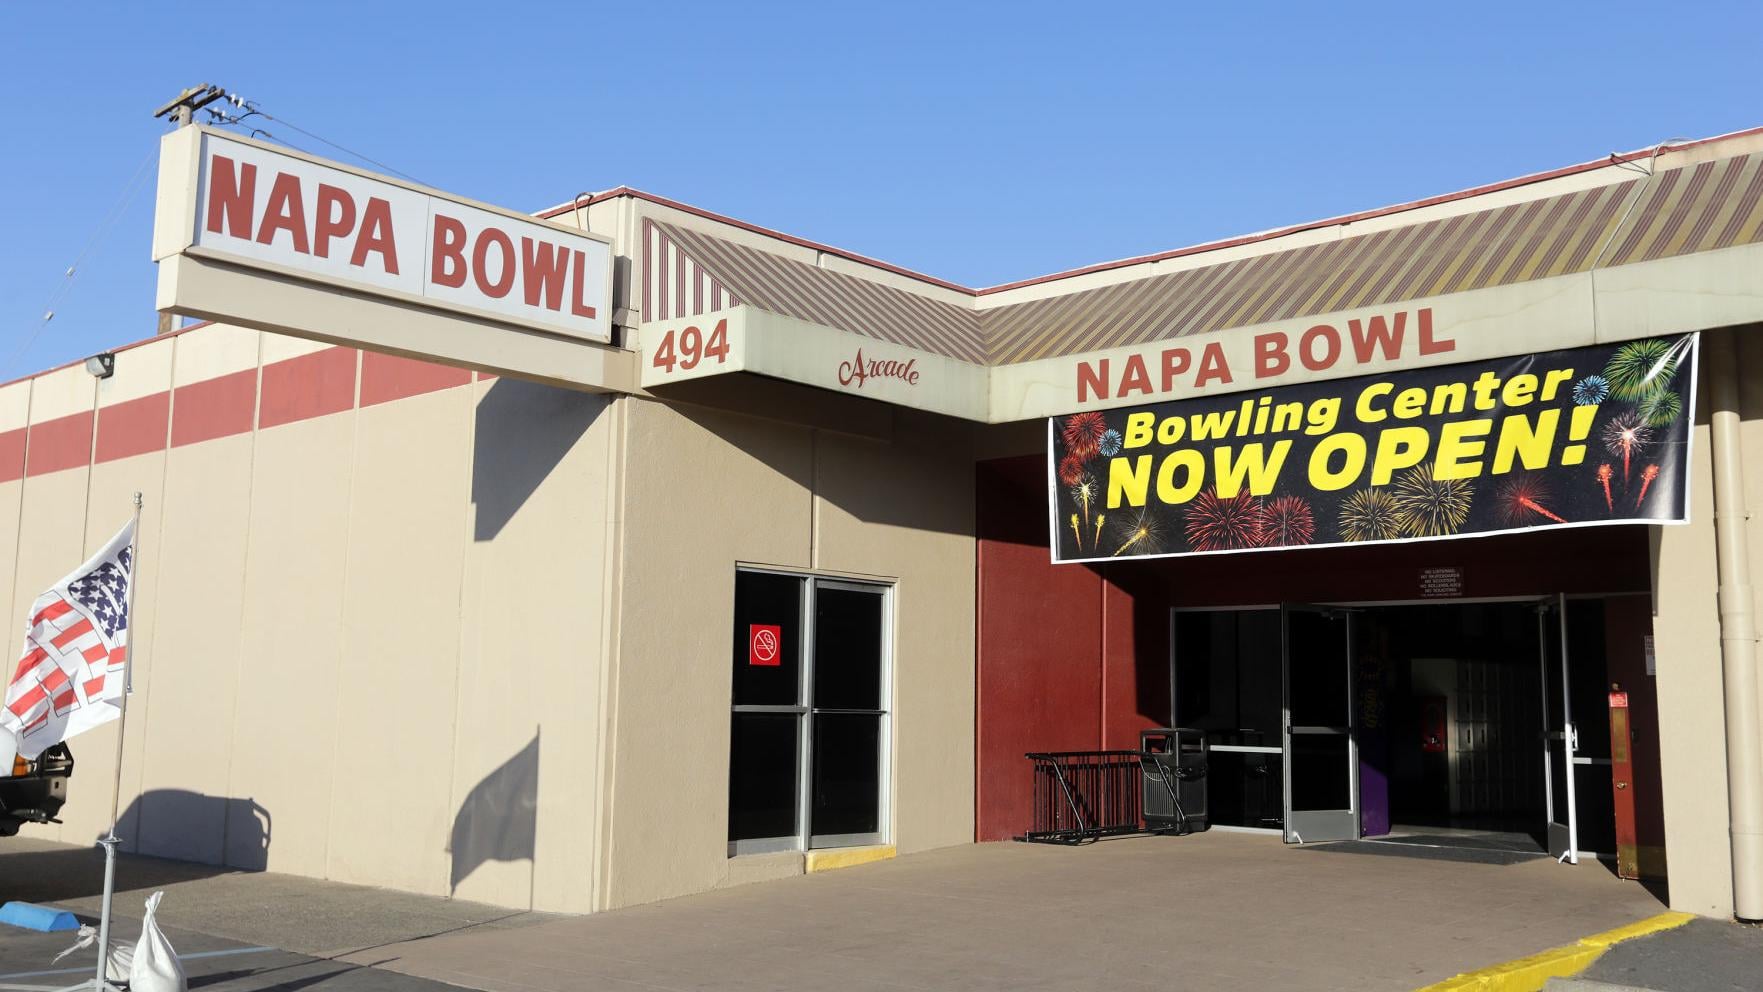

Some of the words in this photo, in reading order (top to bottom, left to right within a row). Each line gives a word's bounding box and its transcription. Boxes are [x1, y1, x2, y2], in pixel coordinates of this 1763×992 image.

[207, 154, 400, 276] NAPA
[431, 214, 596, 319] BOWL
[653, 318, 730, 374] 494
[838, 347, 920, 389] Arcade
[1076, 342, 1233, 403] NAPA
[1254, 308, 1456, 379] BOWL
[1124, 396, 1341, 449] Bowling
[1356, 369, 1574, 422] Center
[1107, 438, 1292, 509] NOW
[1308, 404, 1599, 492] OPEN!
